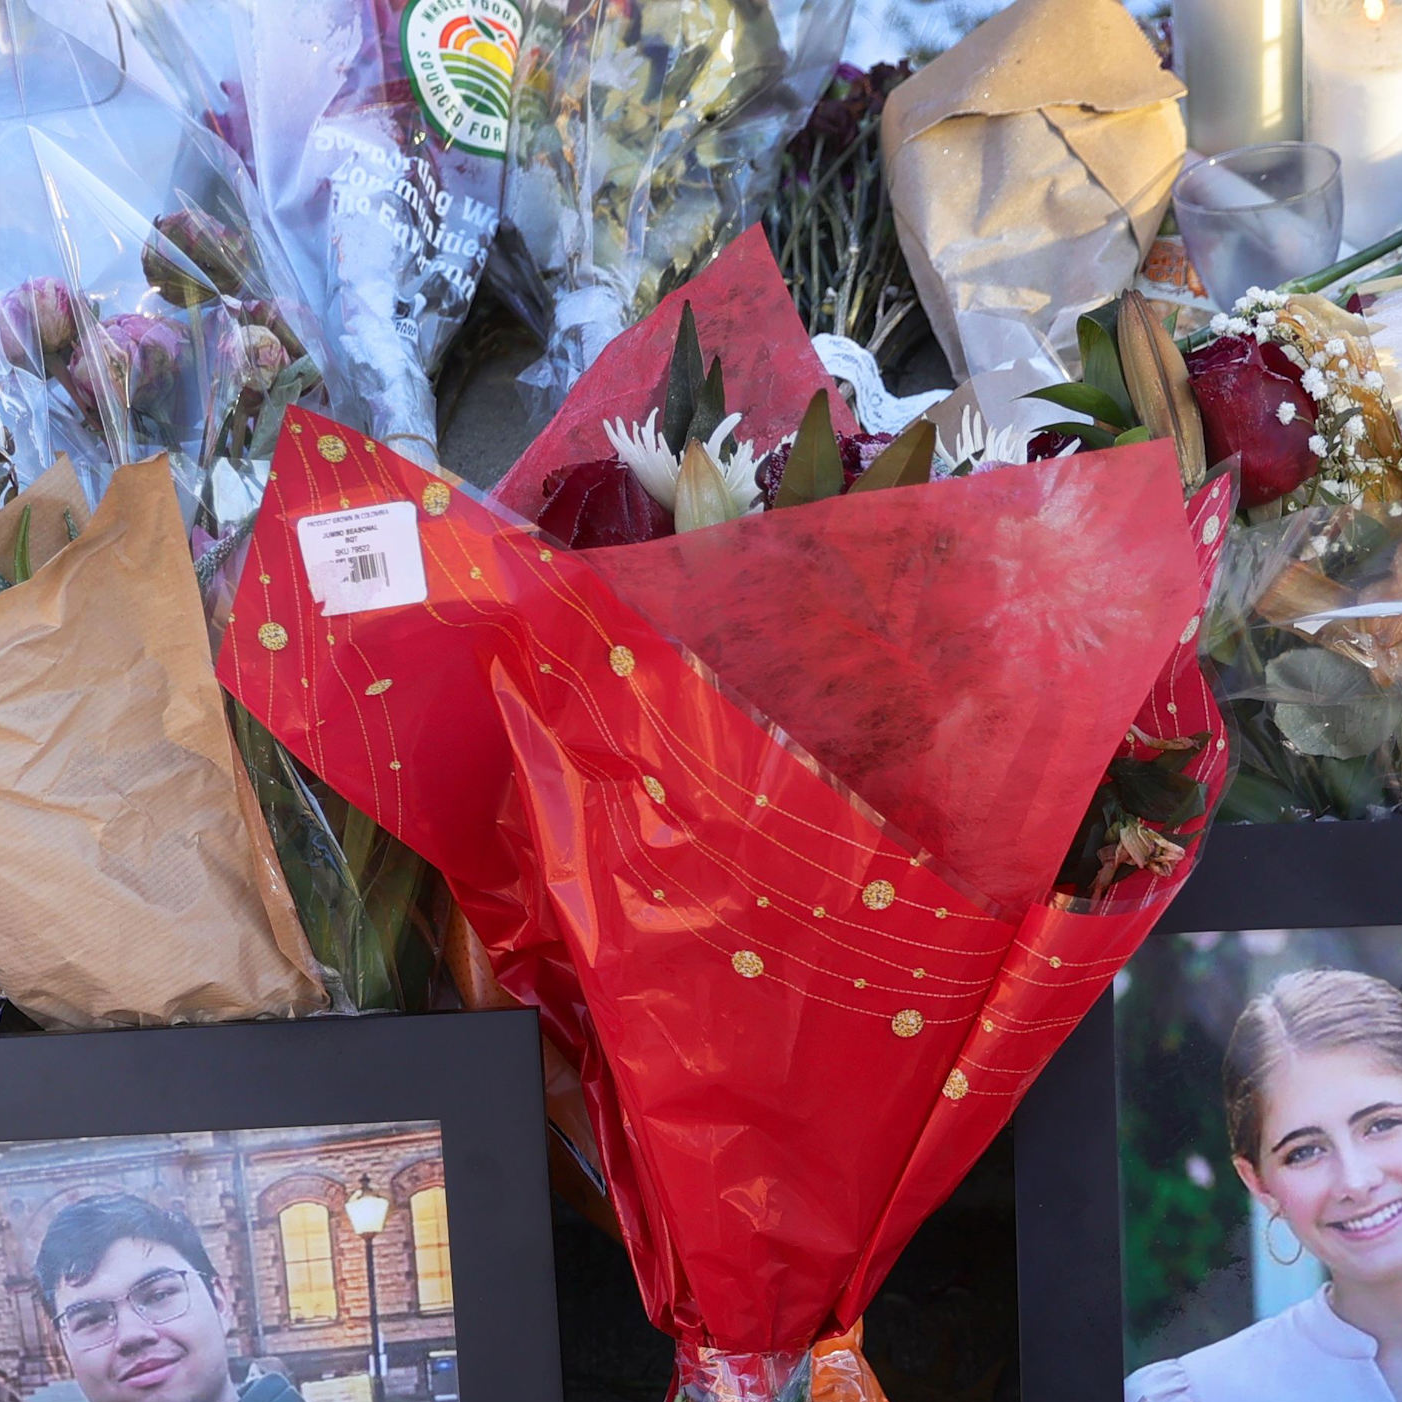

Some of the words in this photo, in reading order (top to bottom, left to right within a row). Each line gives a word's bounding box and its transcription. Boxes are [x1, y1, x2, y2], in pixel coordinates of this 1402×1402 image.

[418, 50, 464, 126] SOURCED
[469, 122, 502, 142] FOR
[335, 548, 350, 556] SKU
